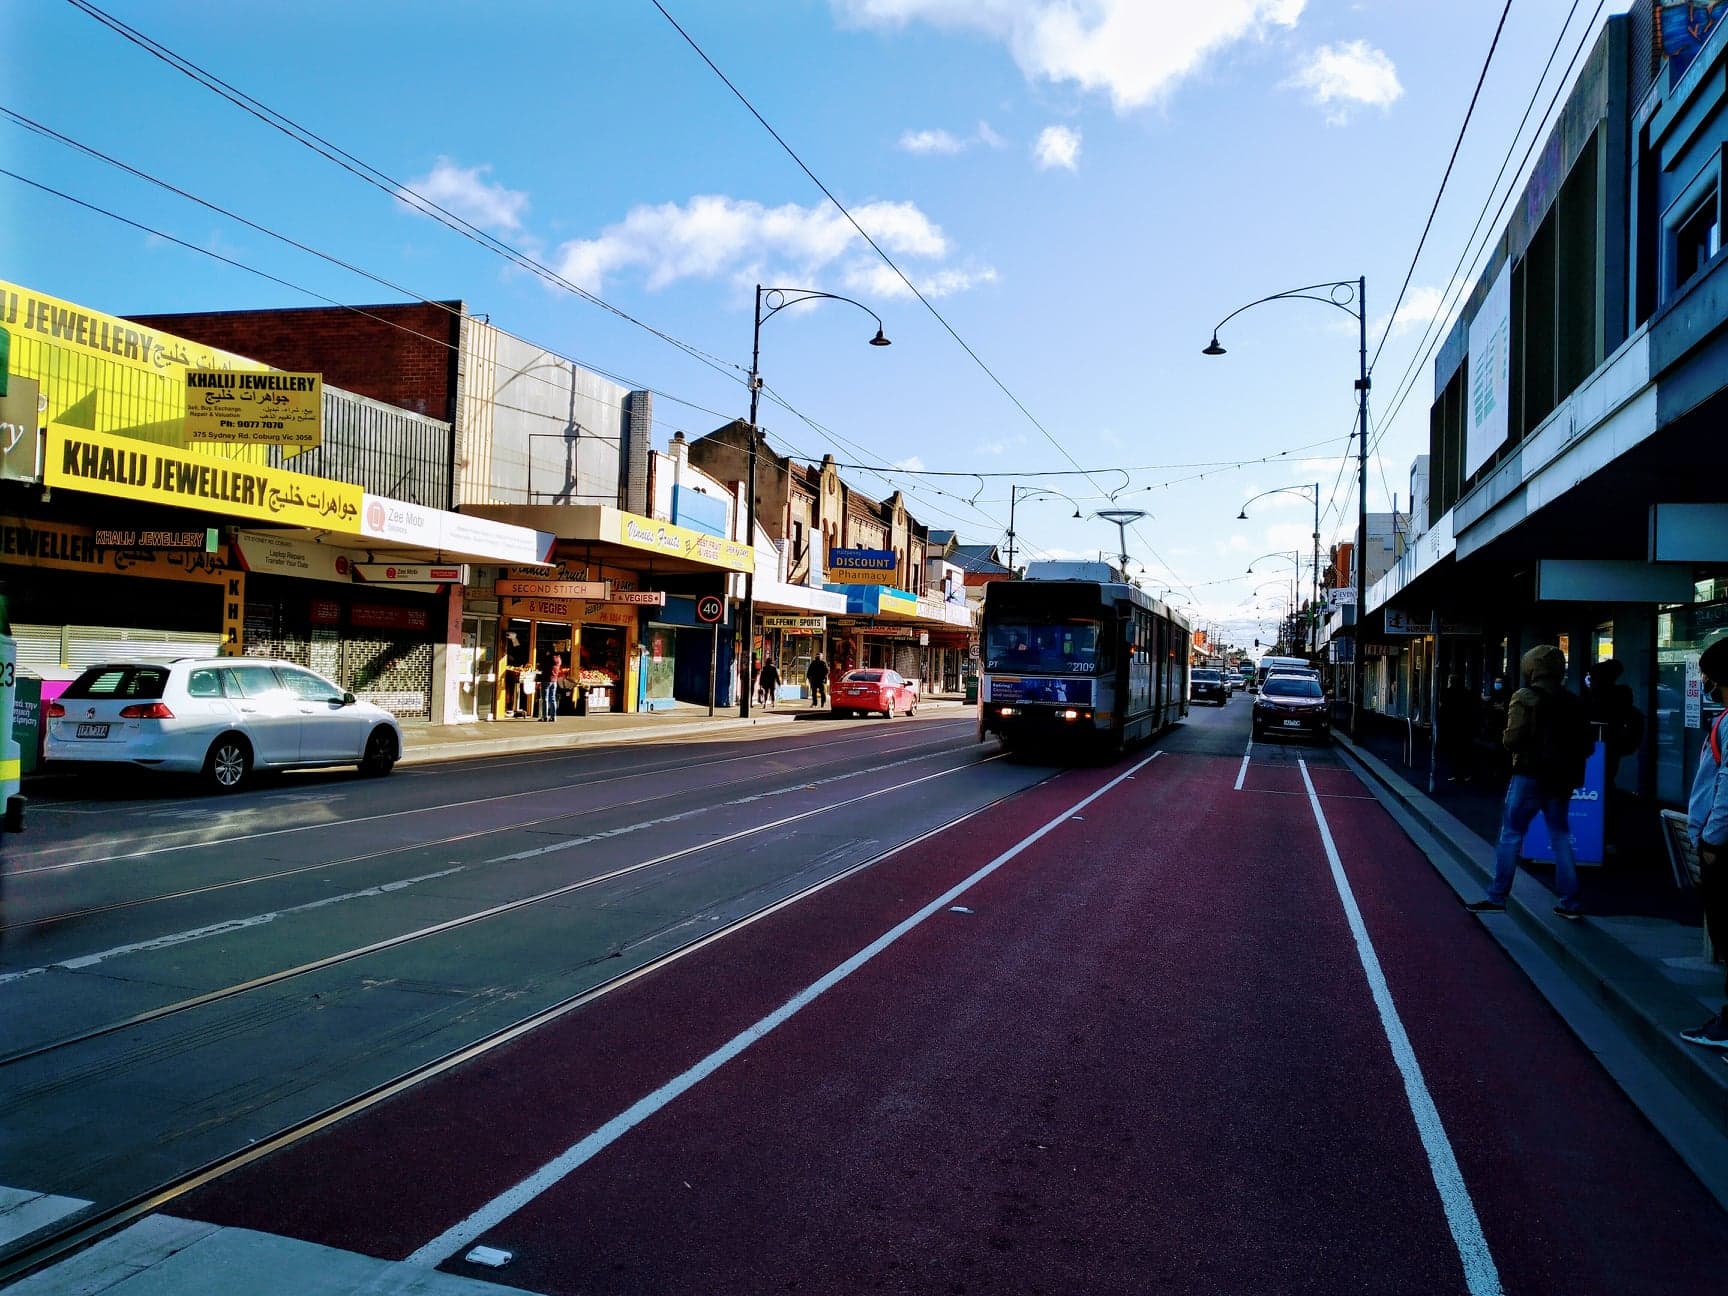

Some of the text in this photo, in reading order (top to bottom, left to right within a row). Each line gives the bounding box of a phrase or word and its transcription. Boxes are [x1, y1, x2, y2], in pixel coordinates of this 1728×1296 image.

[0, 288, 153, 363] IJ JEWELLERY
[153, 342, 191, 369] خليج
[187, 372, 316, 392] KHALIJ JEWELLERY
[205, 388, 290, 405] جواهرات خليج
[220, 420, 284, 429] Ph: 9077 7070
[208, 431, 236, 440] Sydney
[252, 432, 281, 441] Coburg
[281, 433, 294, 441] Vic
[62, 438, 270, 507] KHALIJ JEWELLERY
[268, 483, 358, 521] جواهرات خليج
[387, 507, 425, 529] Zee Mobi
[95, 529, 205, 548] KHALIJ JEWELLERY
[836, 557, 891, 569] DISCOUNT
[838, 569, 888, 582] Pharmacy
[512, 584, 587, 594] SECOND STITCH
[624, 593, 654, 603] VEGIES
[529, 600, 568, 616] & VEGIES
[703, 602, 719, 616] 40
[765, 617, 797, 627] HALFPENNY
[799, 617, 822, 627] SPORTS
[1072, 662, 1095, 672] 2109
